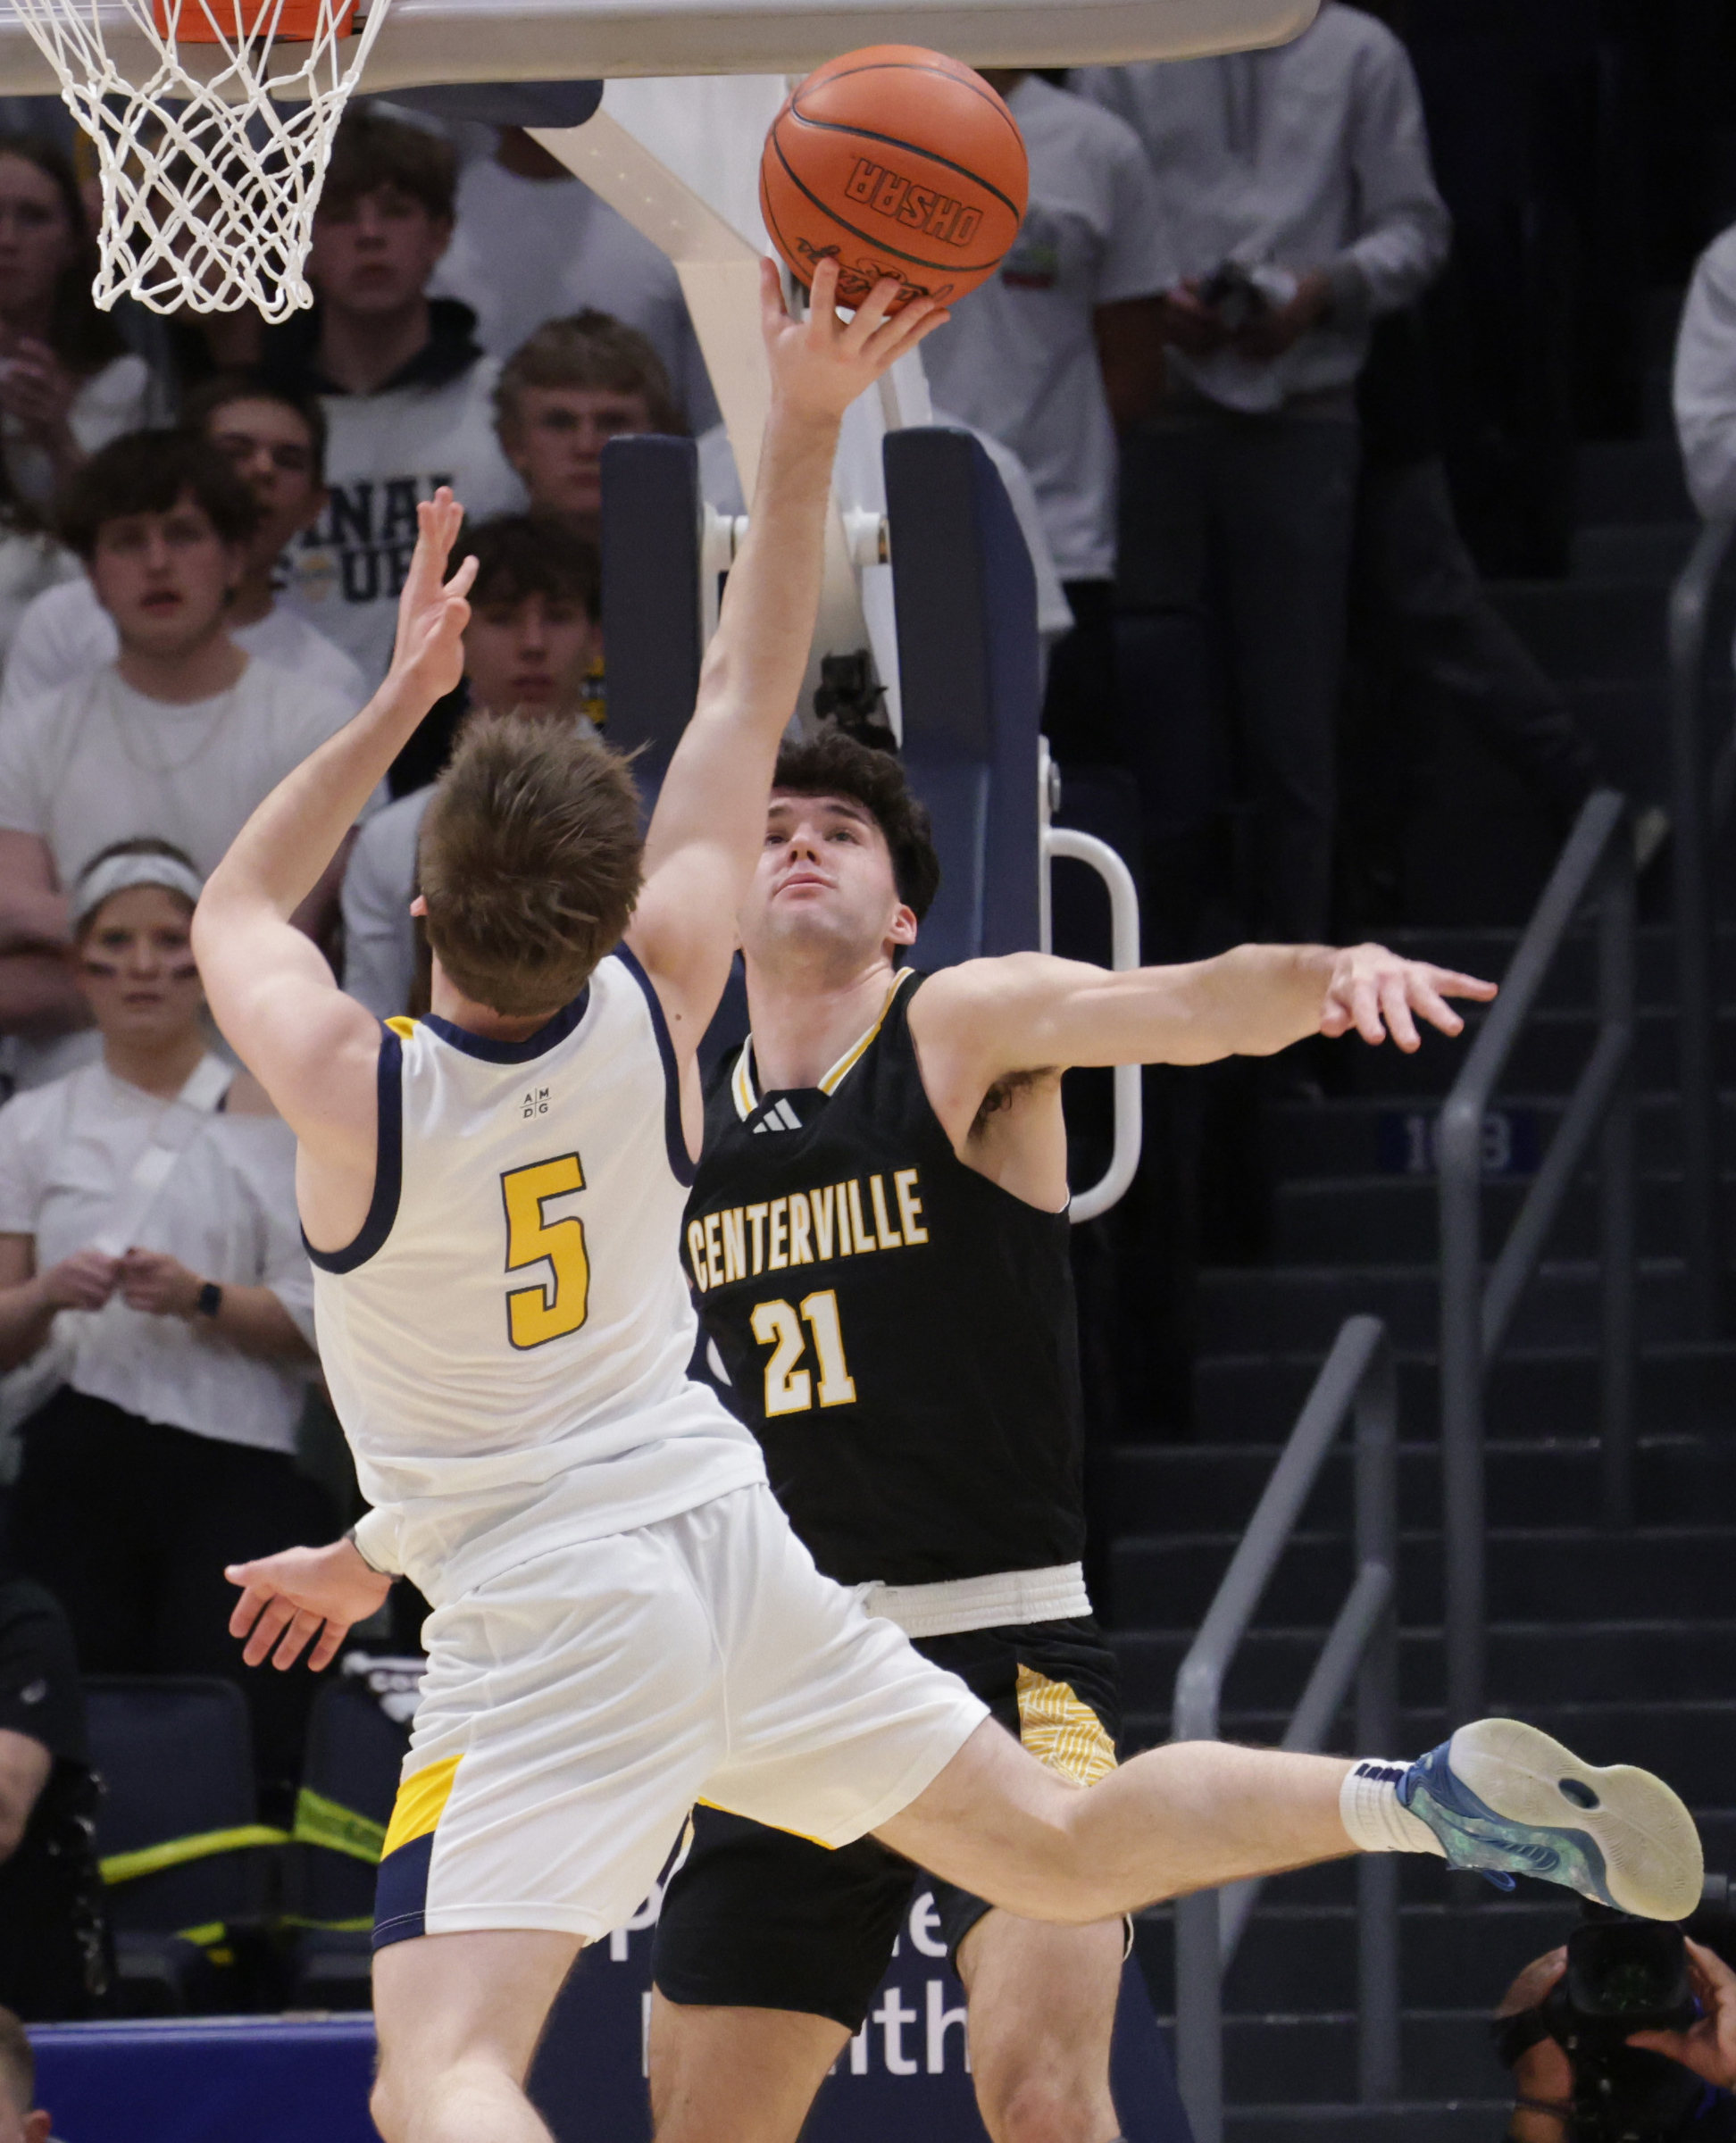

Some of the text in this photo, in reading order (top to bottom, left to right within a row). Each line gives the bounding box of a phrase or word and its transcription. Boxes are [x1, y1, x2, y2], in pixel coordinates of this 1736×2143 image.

[845, 158, 983, 247] OHSAA
[1406, 1115, 1512, 1171] 18
[500, 1151, 590, 1351] 5
[687, 1168, 930, 1294] CENTERVILLE
[749, 1288, 857, 1418] 21
